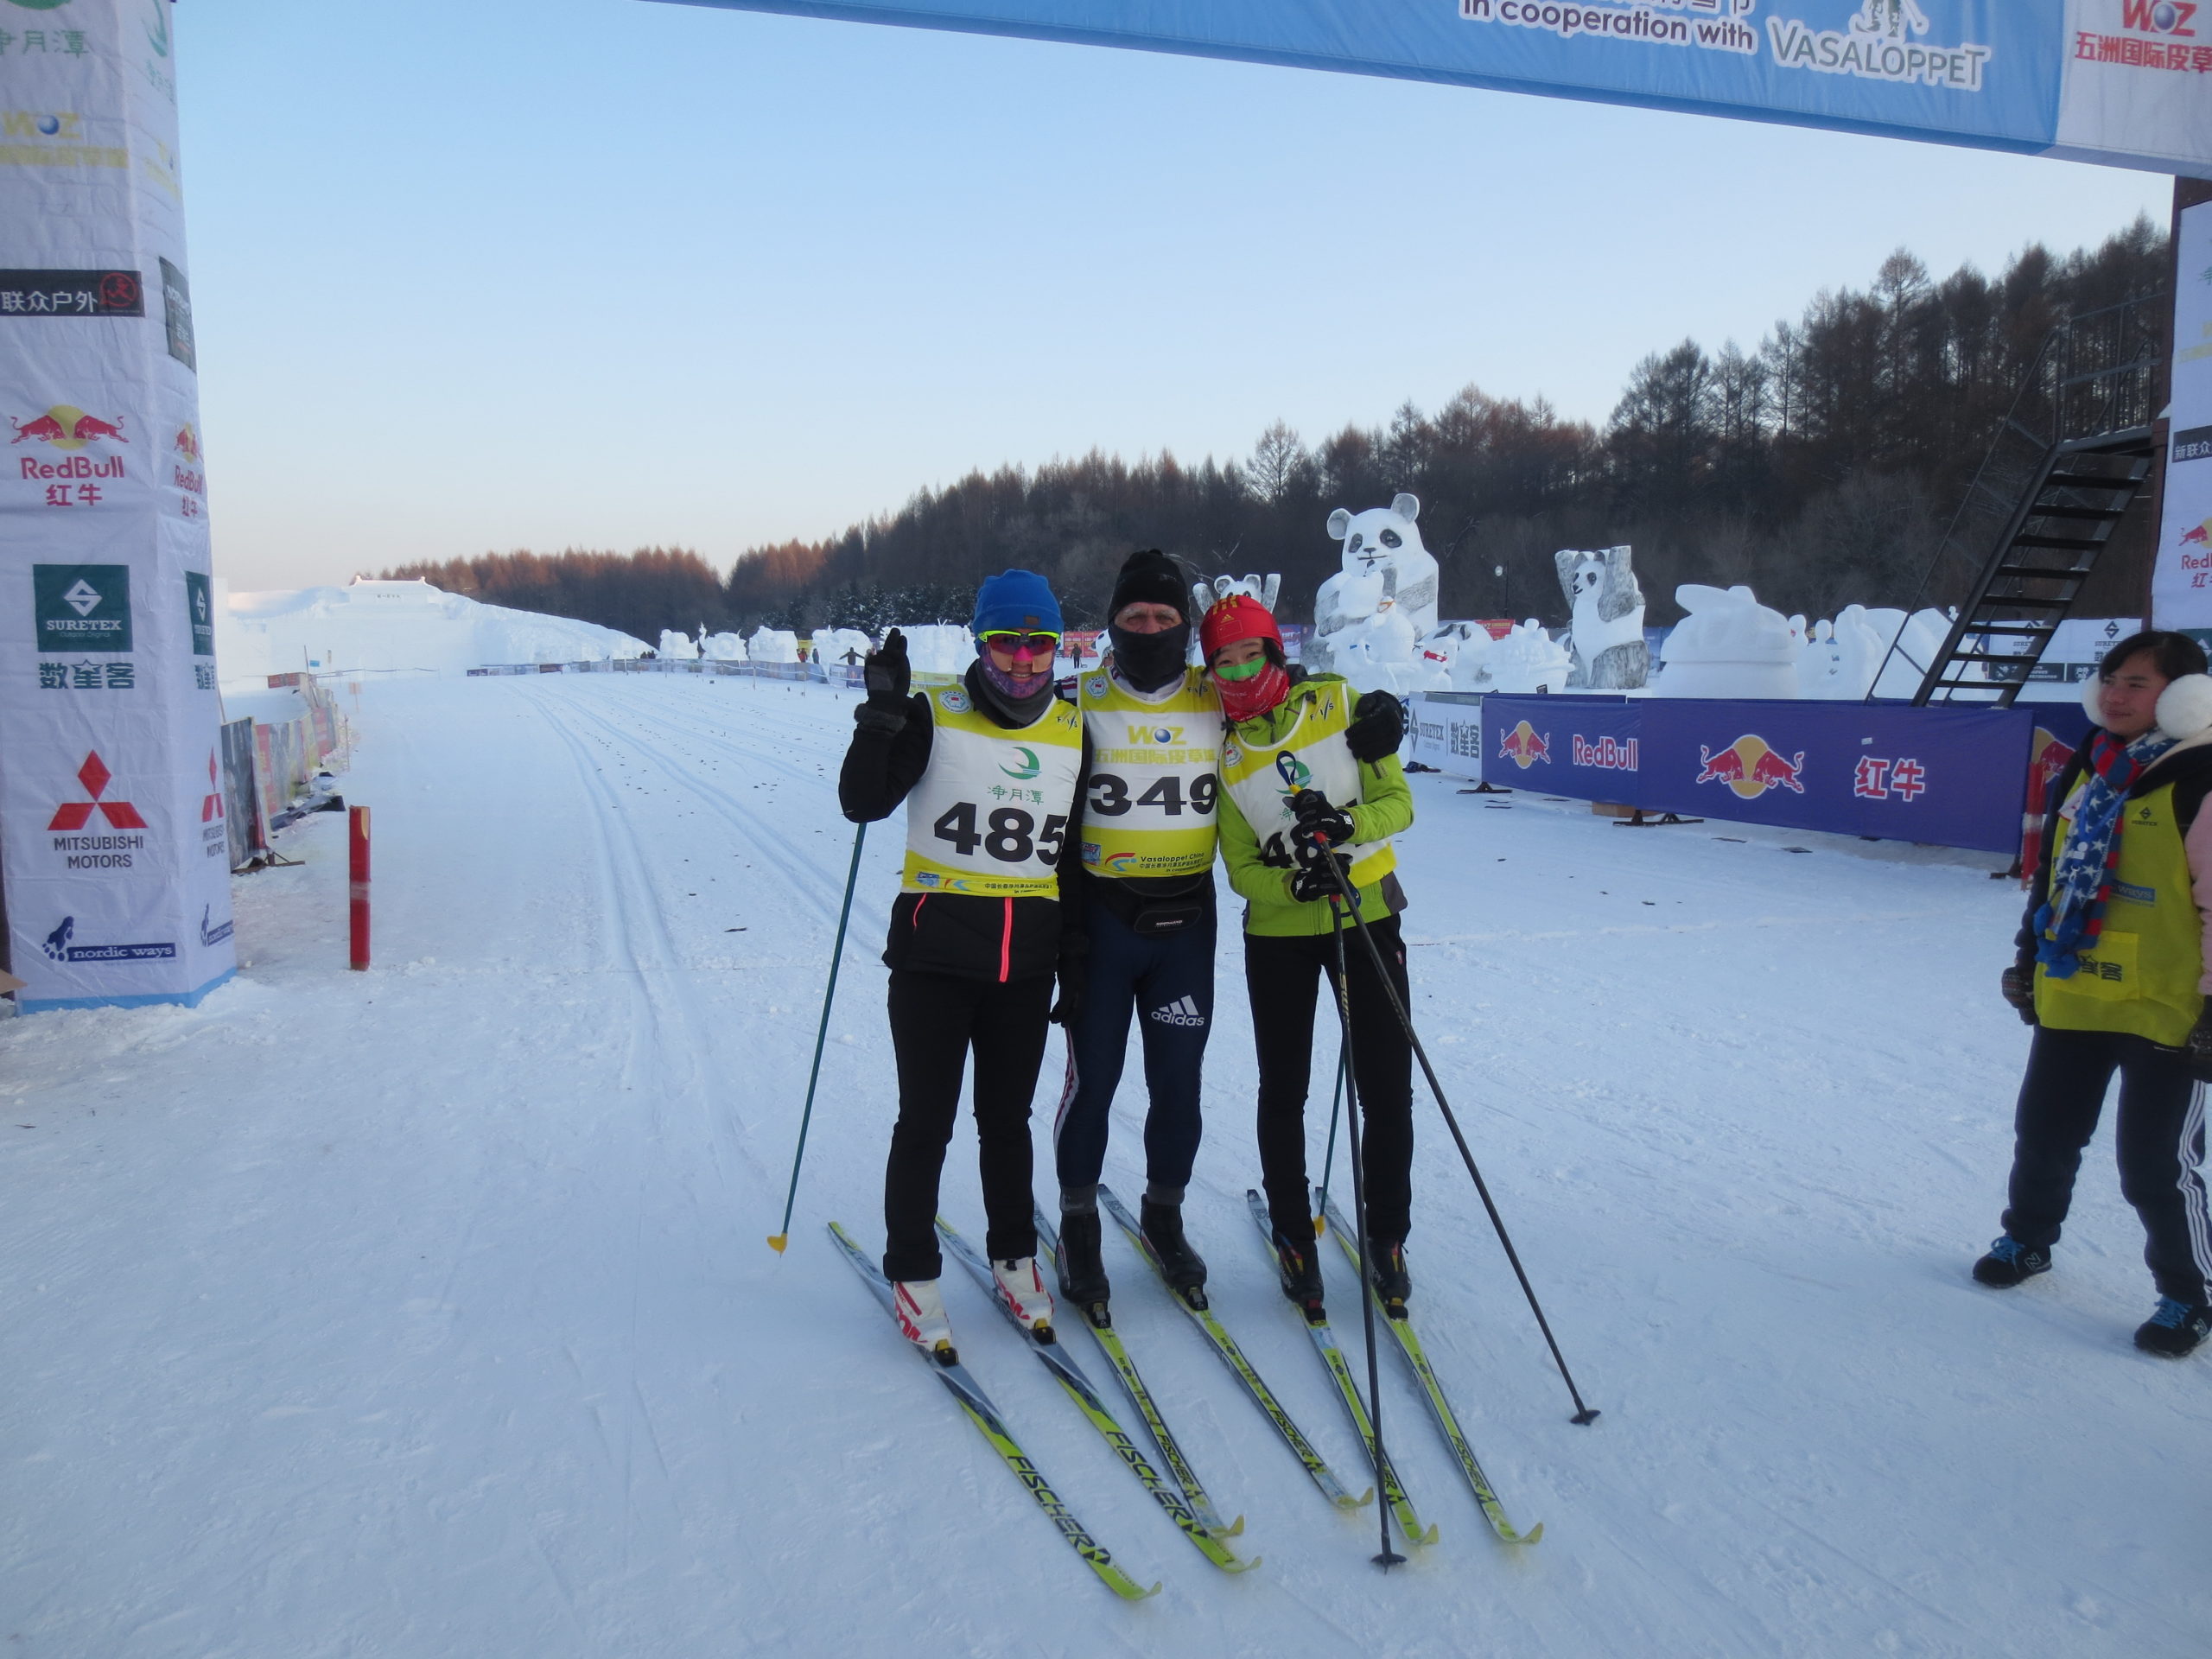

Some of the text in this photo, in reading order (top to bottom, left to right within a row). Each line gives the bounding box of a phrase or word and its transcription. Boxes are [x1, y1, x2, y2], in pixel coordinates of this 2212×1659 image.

[1500, 0, 1686, 41] cooperation
[1698, 21, 1753, 50] with
[1771, 22, 1986, 86] VASALOPPET
[2075, 31, 2212, 73] 五洲国际皮草
[1, 290, 98, 313] 联众户外
[2175, 440, 2212, 461] 新联众
[21, 456, 125, 480] RedBull
[46, 484, 103, 506] 红牛
[181, 495, 199, 517] 红牛
[2191, 573, 2212, 588] 红
[47, 620, 123, 631] SURETEX
[1573, 734, 1638, 772] RedBull
[1853, 755, 1925, 802] 红牛
[987, 785, 1044, 805] 净月潭
[1088, 773, 1217, 817] 349
[54, 836, 143, 851] MITSUBISHI
[934, 802, 1068, 866] 485
[68, 854, 133, 869] MOTORS
[73, 947, 173, 958] nordic ways
[1151, 1011, 1205, 1027] adidas
[1157, 1433, 1194, 1484] FISCHER
[1451, 1434, 1487, 1491] FISCHER
[1106, 1431, 1193, 1522] FISCHER
[1007, 1455, 1096, 1549] FISCHER
